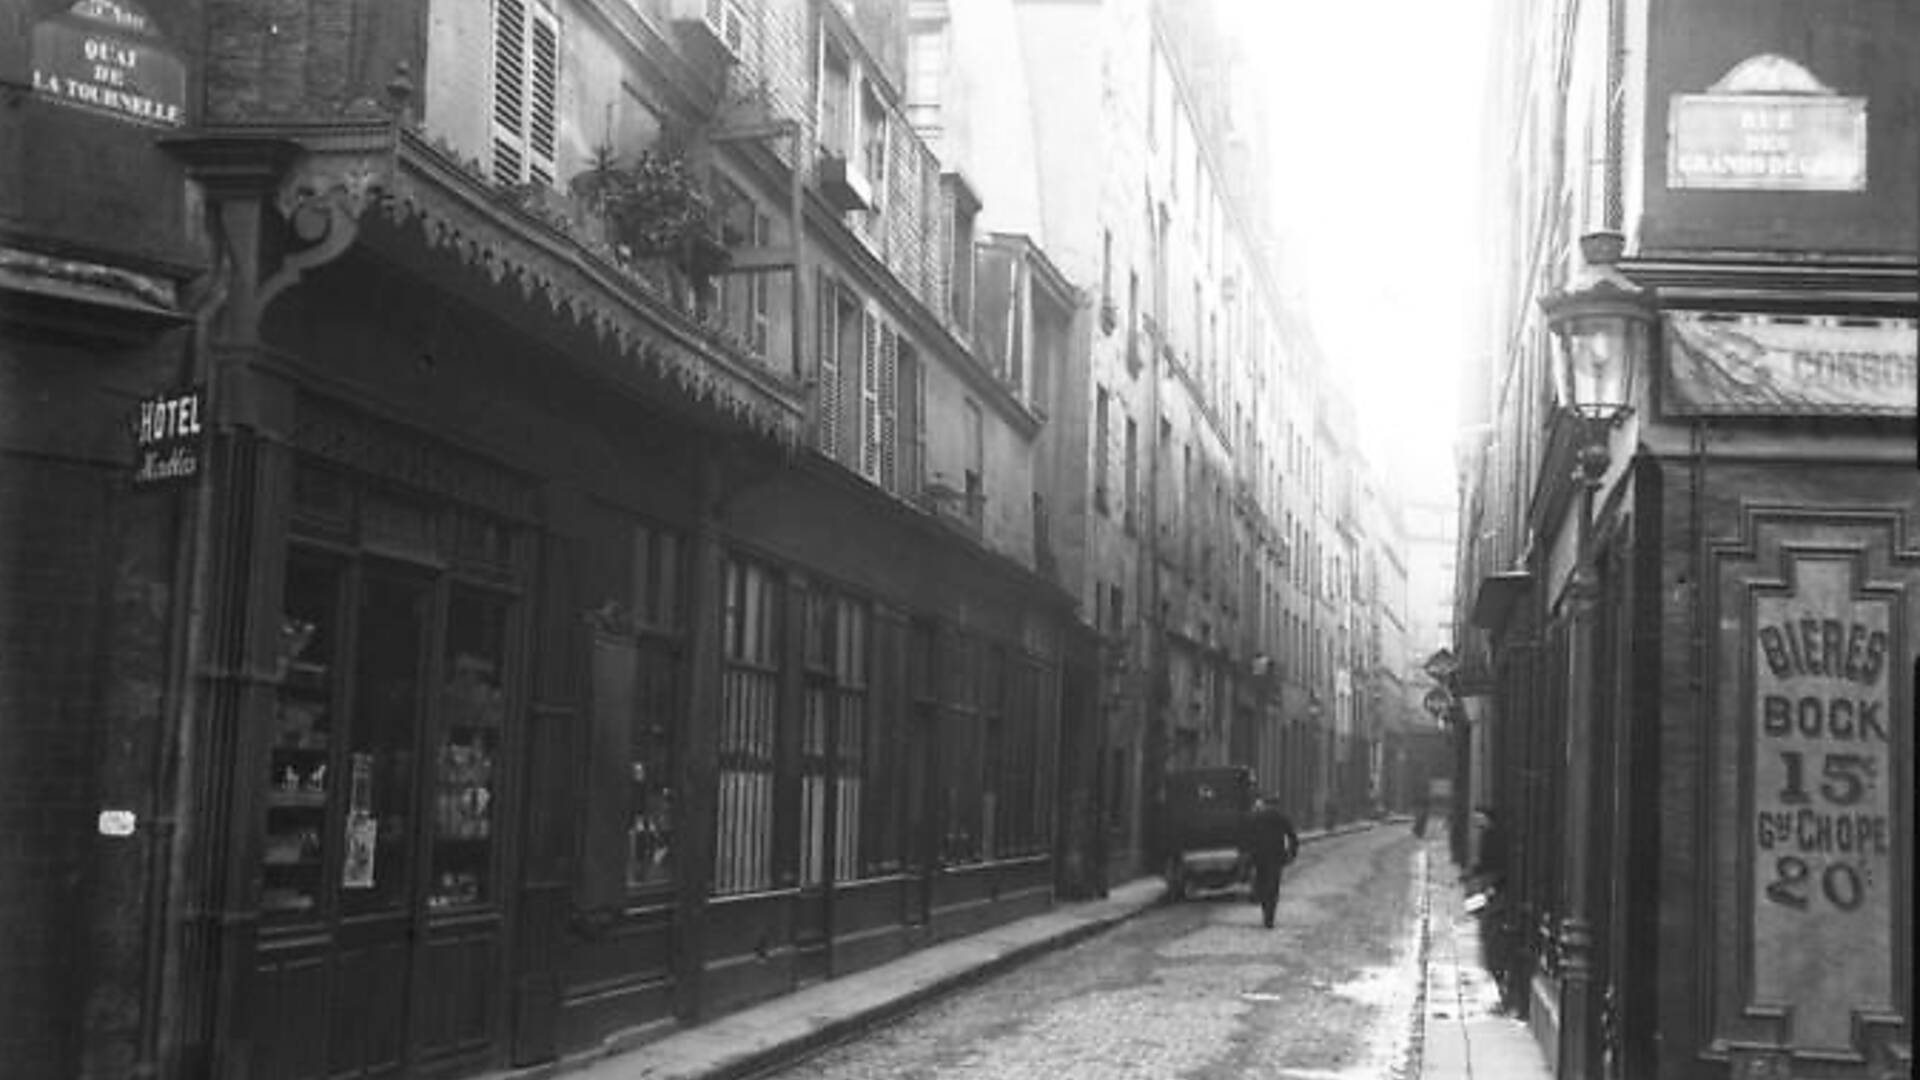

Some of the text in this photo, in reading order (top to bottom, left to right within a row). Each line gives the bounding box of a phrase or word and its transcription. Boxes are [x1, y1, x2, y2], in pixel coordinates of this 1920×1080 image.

[84, 39, 136, 68] QUAI
[94, 64, 124, 88] DE
[33, 69, 180, 124] LA TOURNELLE
[1741, 109, 1794, 129] RUE
[1764, 695, 1888, 742] BOCK
[1797, 808, 1887, 854] CHOPE
